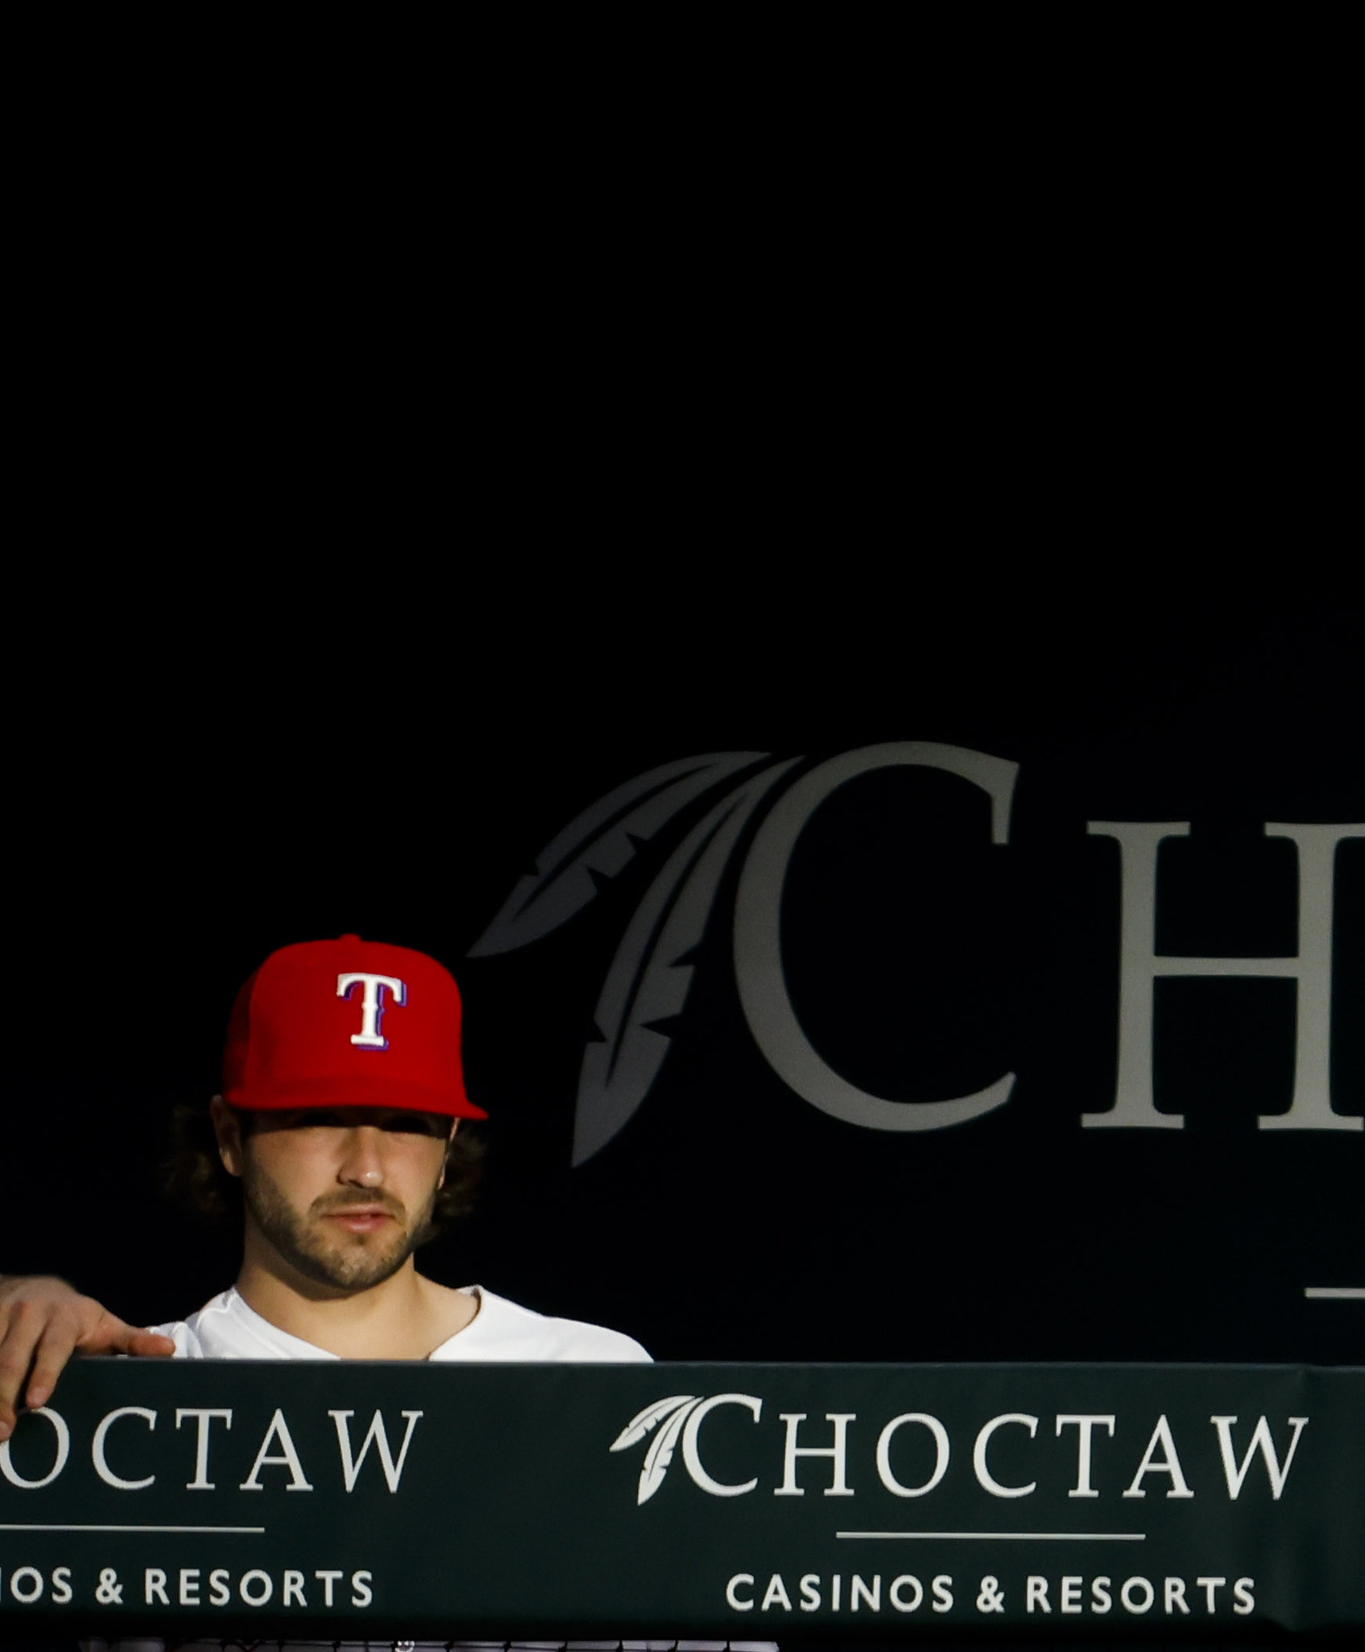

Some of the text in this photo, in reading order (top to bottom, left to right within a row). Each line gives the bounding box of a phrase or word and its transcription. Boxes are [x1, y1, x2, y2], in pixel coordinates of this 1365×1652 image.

[336, 971, 408, 1051] T
[681, 1393, 1310, 1501] CHOCTAW
[95, 1567, 124, 1605] &
[144, 1568, 373, 1608] RESORTS
[725, 1573, 1255, 1615] CASINOS & RESORTS
